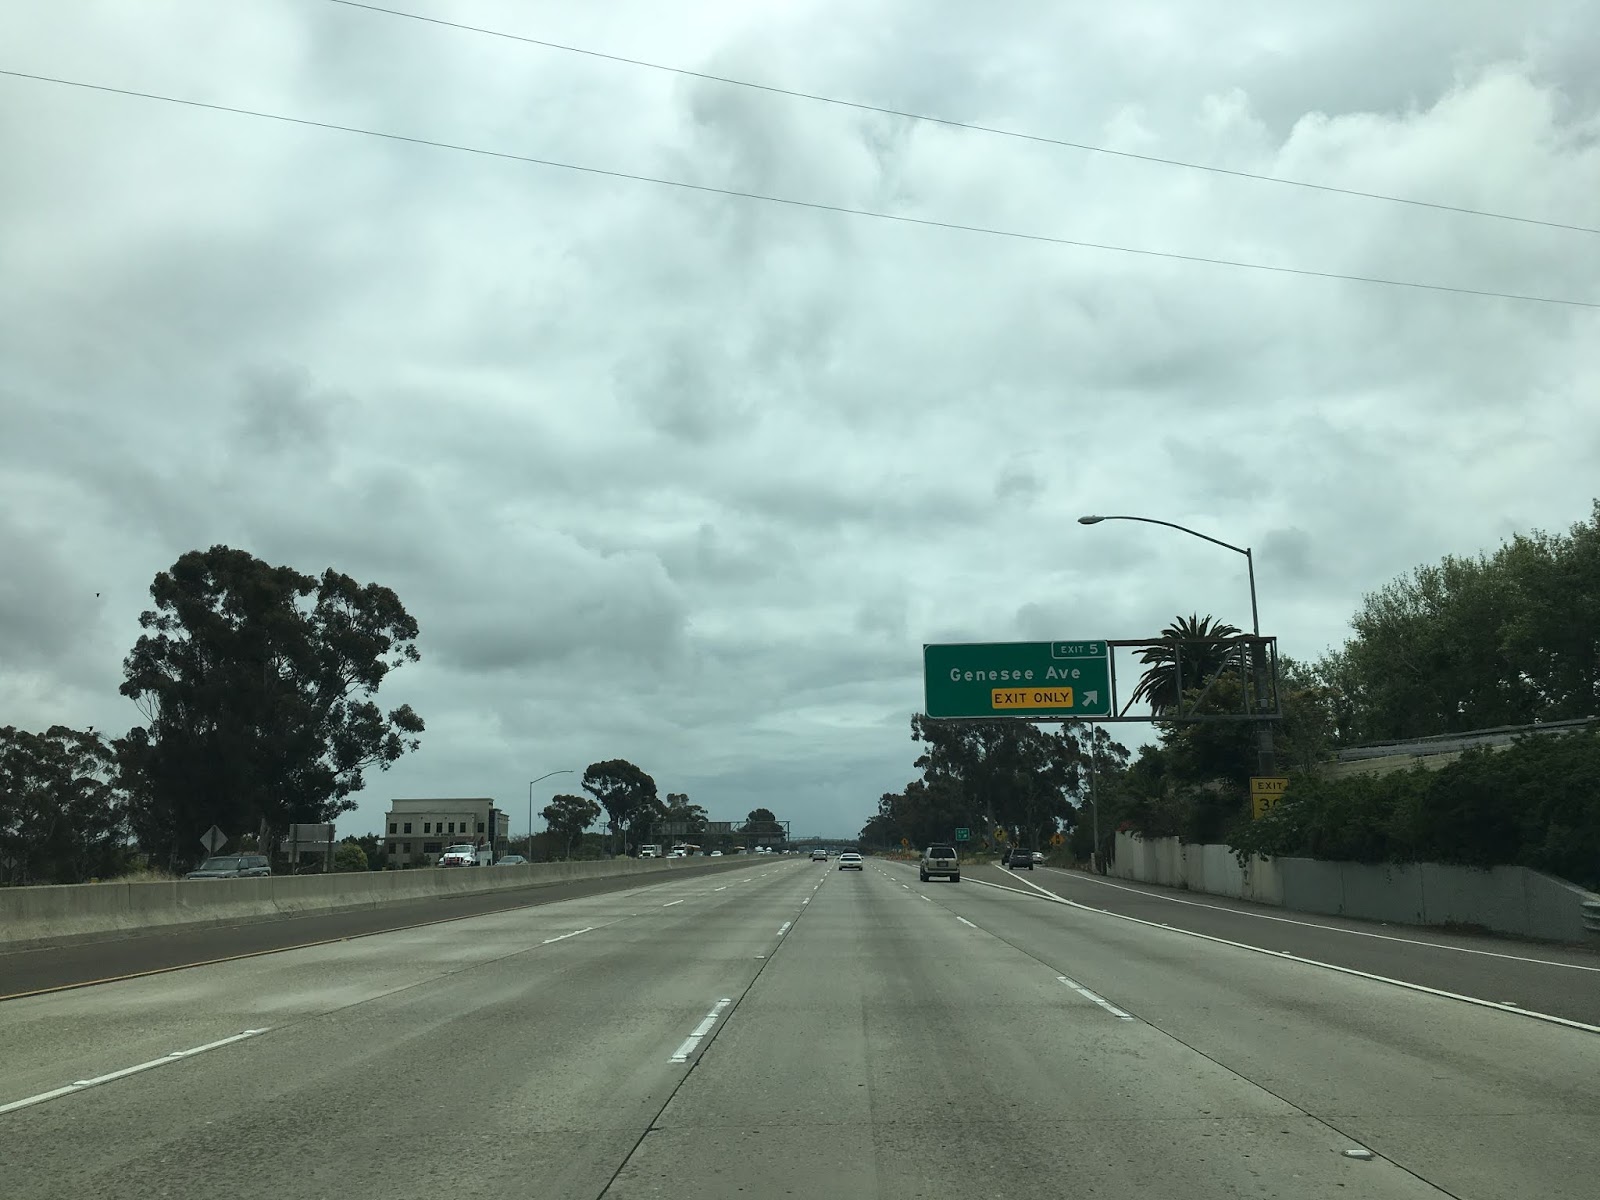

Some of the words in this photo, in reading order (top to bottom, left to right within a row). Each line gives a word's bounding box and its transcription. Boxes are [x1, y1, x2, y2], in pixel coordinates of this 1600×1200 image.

[1060, 646, 1084, 654] EXIT
[1090, 644, 1098, 654] 5
[949, 667, 1034, 682] Genesee
[1045, 665, 1081, 680] Ave
[994, 693, 1026, 703] EXIT
[1034, 692, 1070, 702] ONLY
